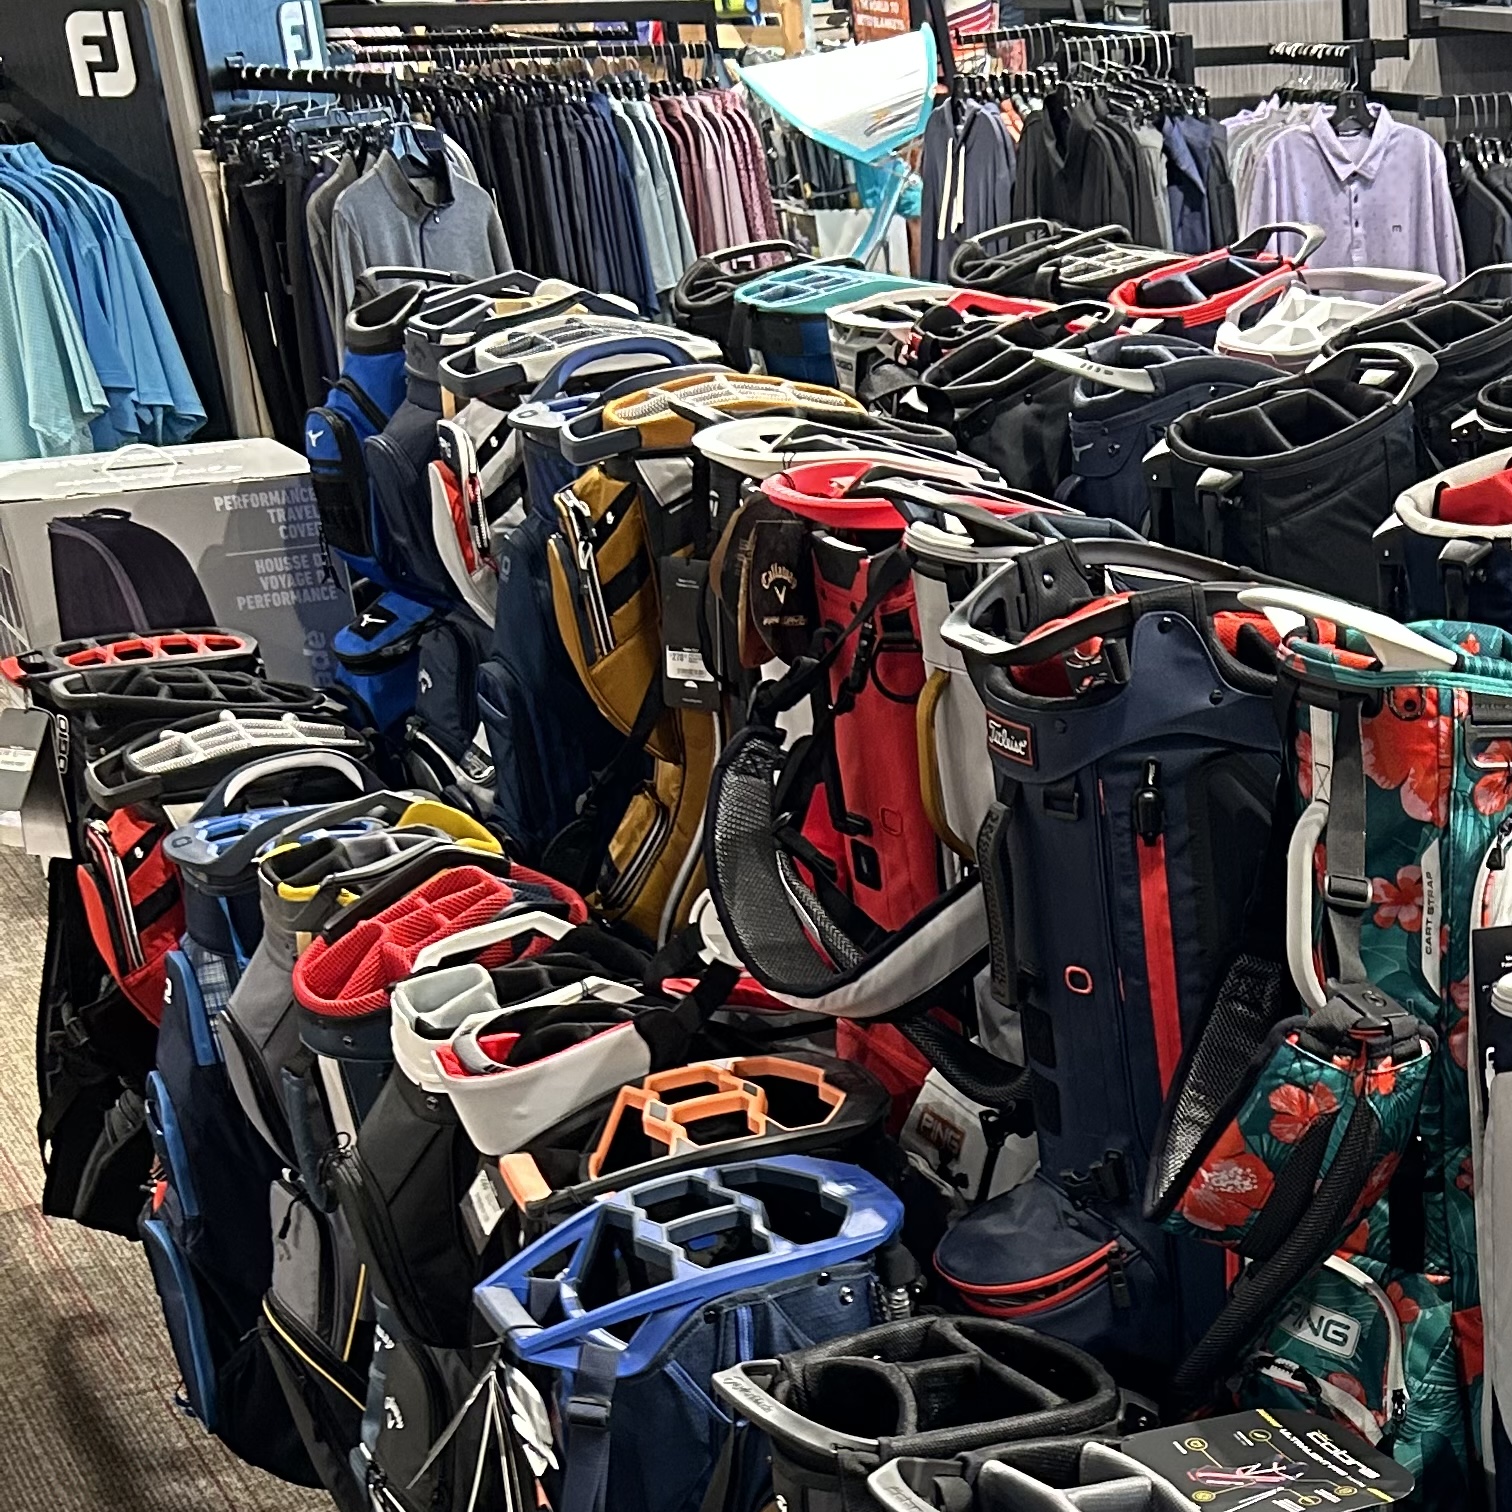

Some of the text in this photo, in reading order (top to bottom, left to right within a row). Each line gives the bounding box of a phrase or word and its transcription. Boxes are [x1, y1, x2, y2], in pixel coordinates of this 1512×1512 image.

[65, 11, 137, 97] FJ
[214, 487, 317, 511] PERFORMANCE
[267, 504, 320, 524] TRAVEL
[255, 556, 303, 574] HOUSSE
[259, 572, 314, 591] VOYAGE
[237, 586, 338, 611] PERFORMANCE
[1425, 871, 1435, 955] CART STRAP
[922, 1111, 961, 1152] PING
[1306, 1430, 1381, 1479] cobra
